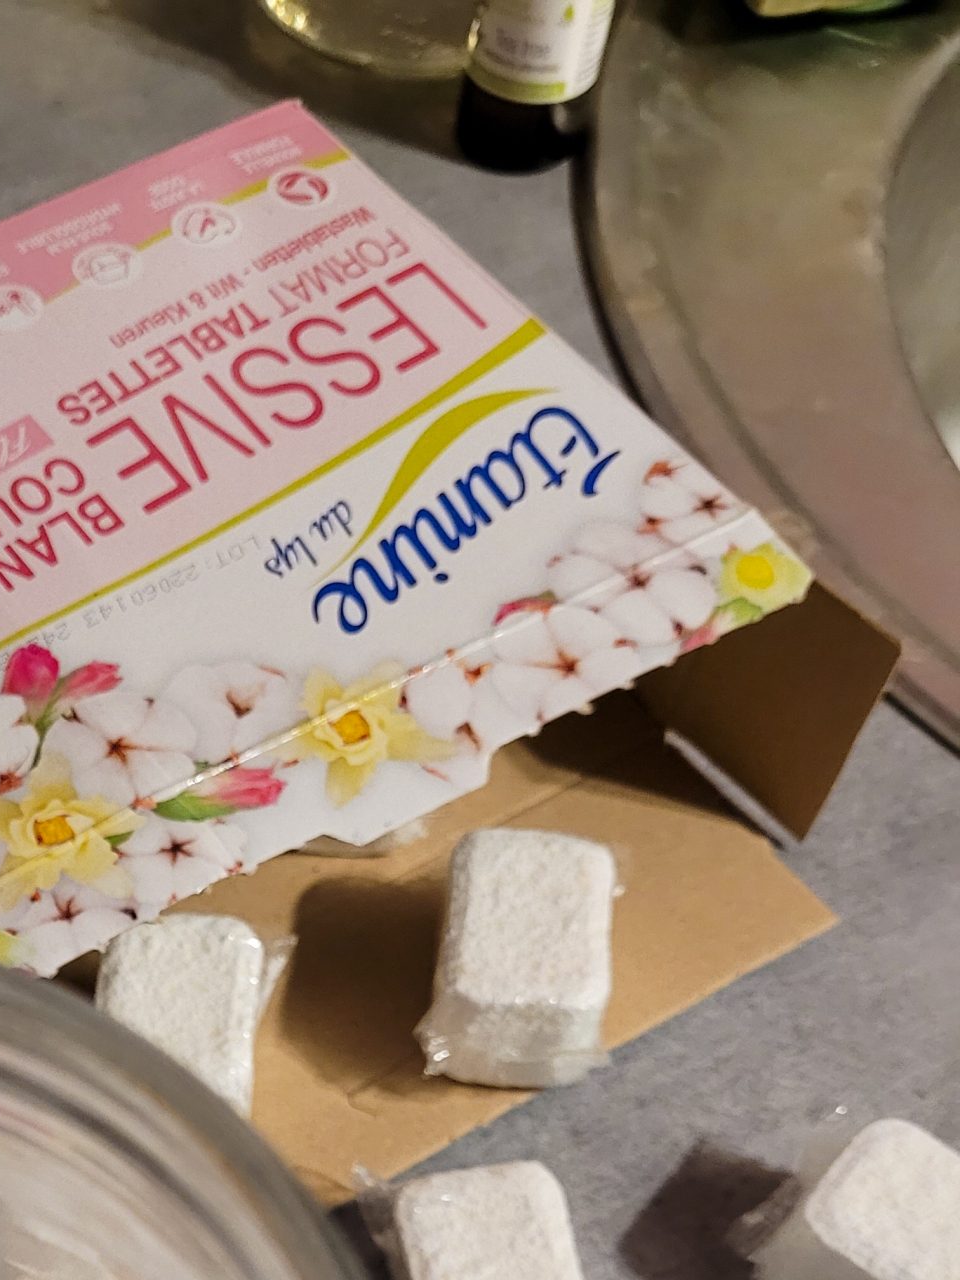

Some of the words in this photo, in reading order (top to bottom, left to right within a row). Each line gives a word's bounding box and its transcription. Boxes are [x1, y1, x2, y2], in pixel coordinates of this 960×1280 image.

[252, 206, 375, 272] Wastabletten
[267, 228, 411, 314] FORMAT
[205, 273, 243, 299] Wit
[109, 300, 190, 349] Kleuren
[56, 302, 271, 426] TABLETTES
[85, 261, 487, 514] LESSIVE
[311, 500, 353, 541] du
[312, 406, 621, 634] Étamine
[263, 535, 318, 578] lys
